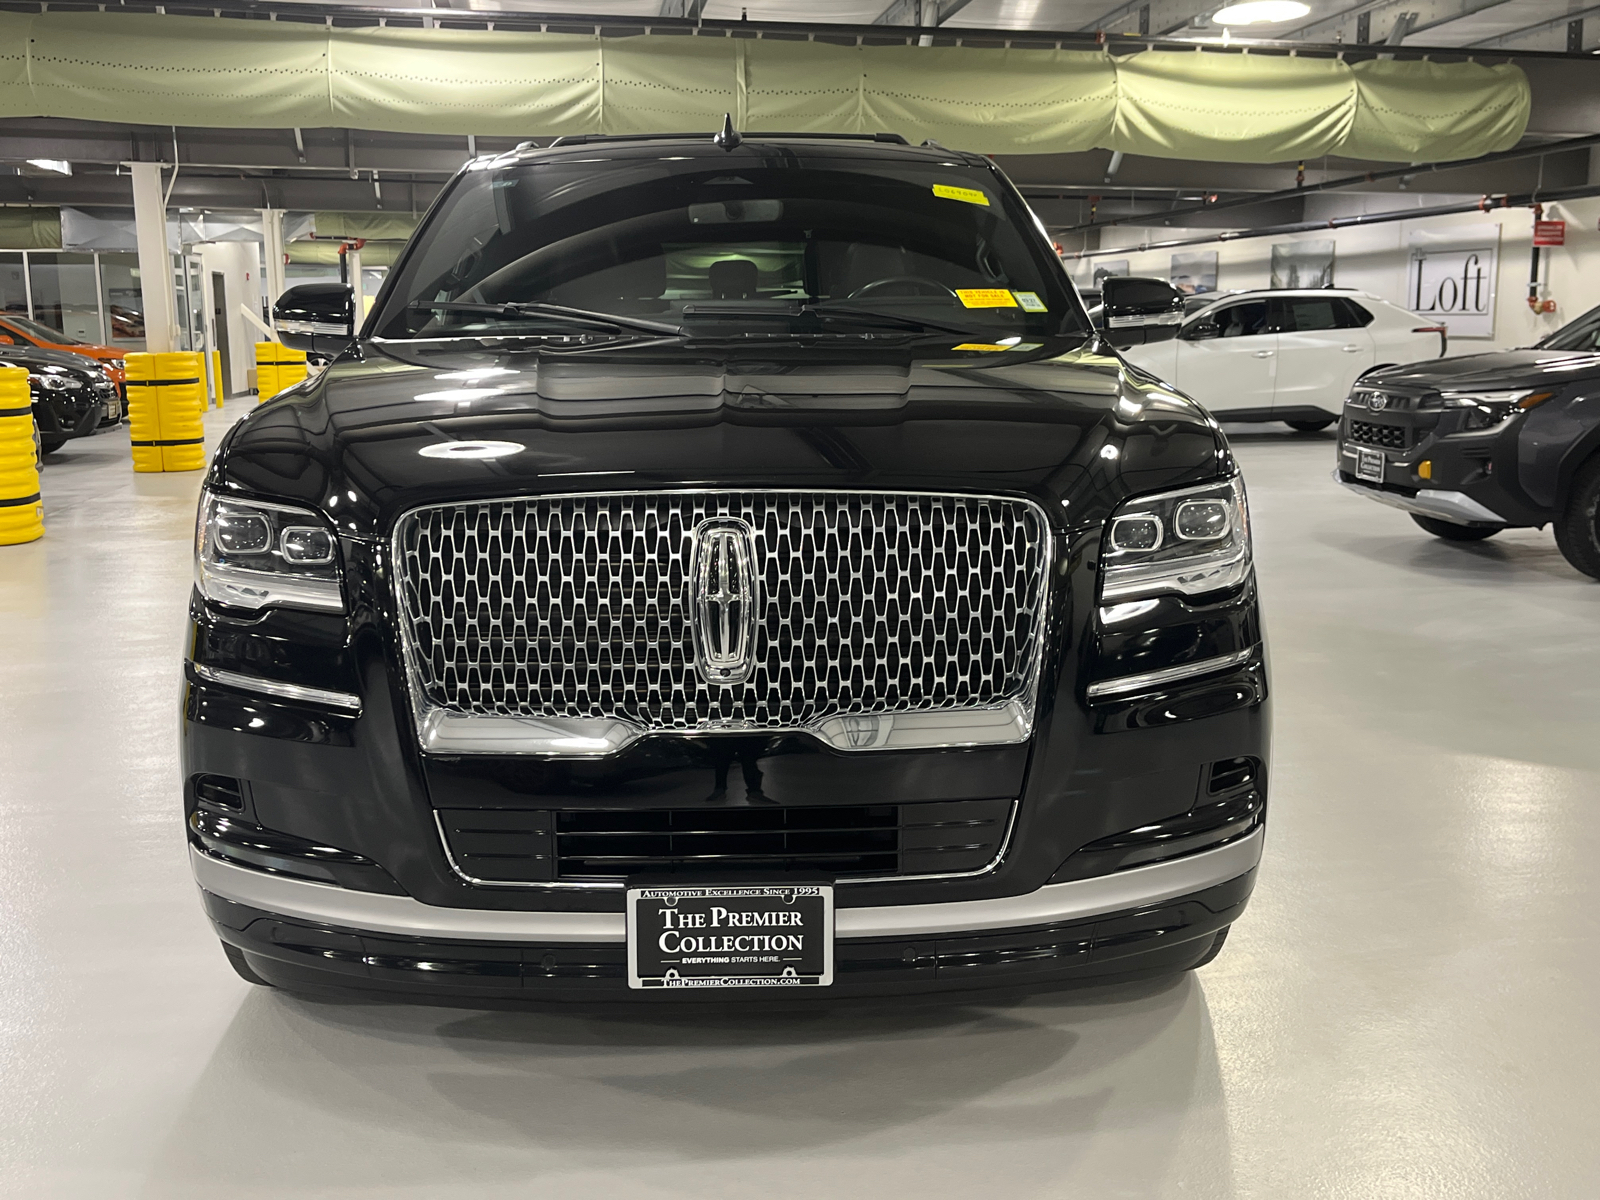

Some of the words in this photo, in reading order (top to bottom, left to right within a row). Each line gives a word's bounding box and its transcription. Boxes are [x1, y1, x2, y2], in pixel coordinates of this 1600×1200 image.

[1411, 253, 1487, 312] Loft
[642, 890, 702, 898] AUTOMOTIVE
[763, 887, 790, 895] SINCE
[793, 887, 819, 895] 1995
[658, 908, 706, 929] THE
[710, 907, 804, 927] PREMIER
[658, 930, 804, 953] COLLECTION
